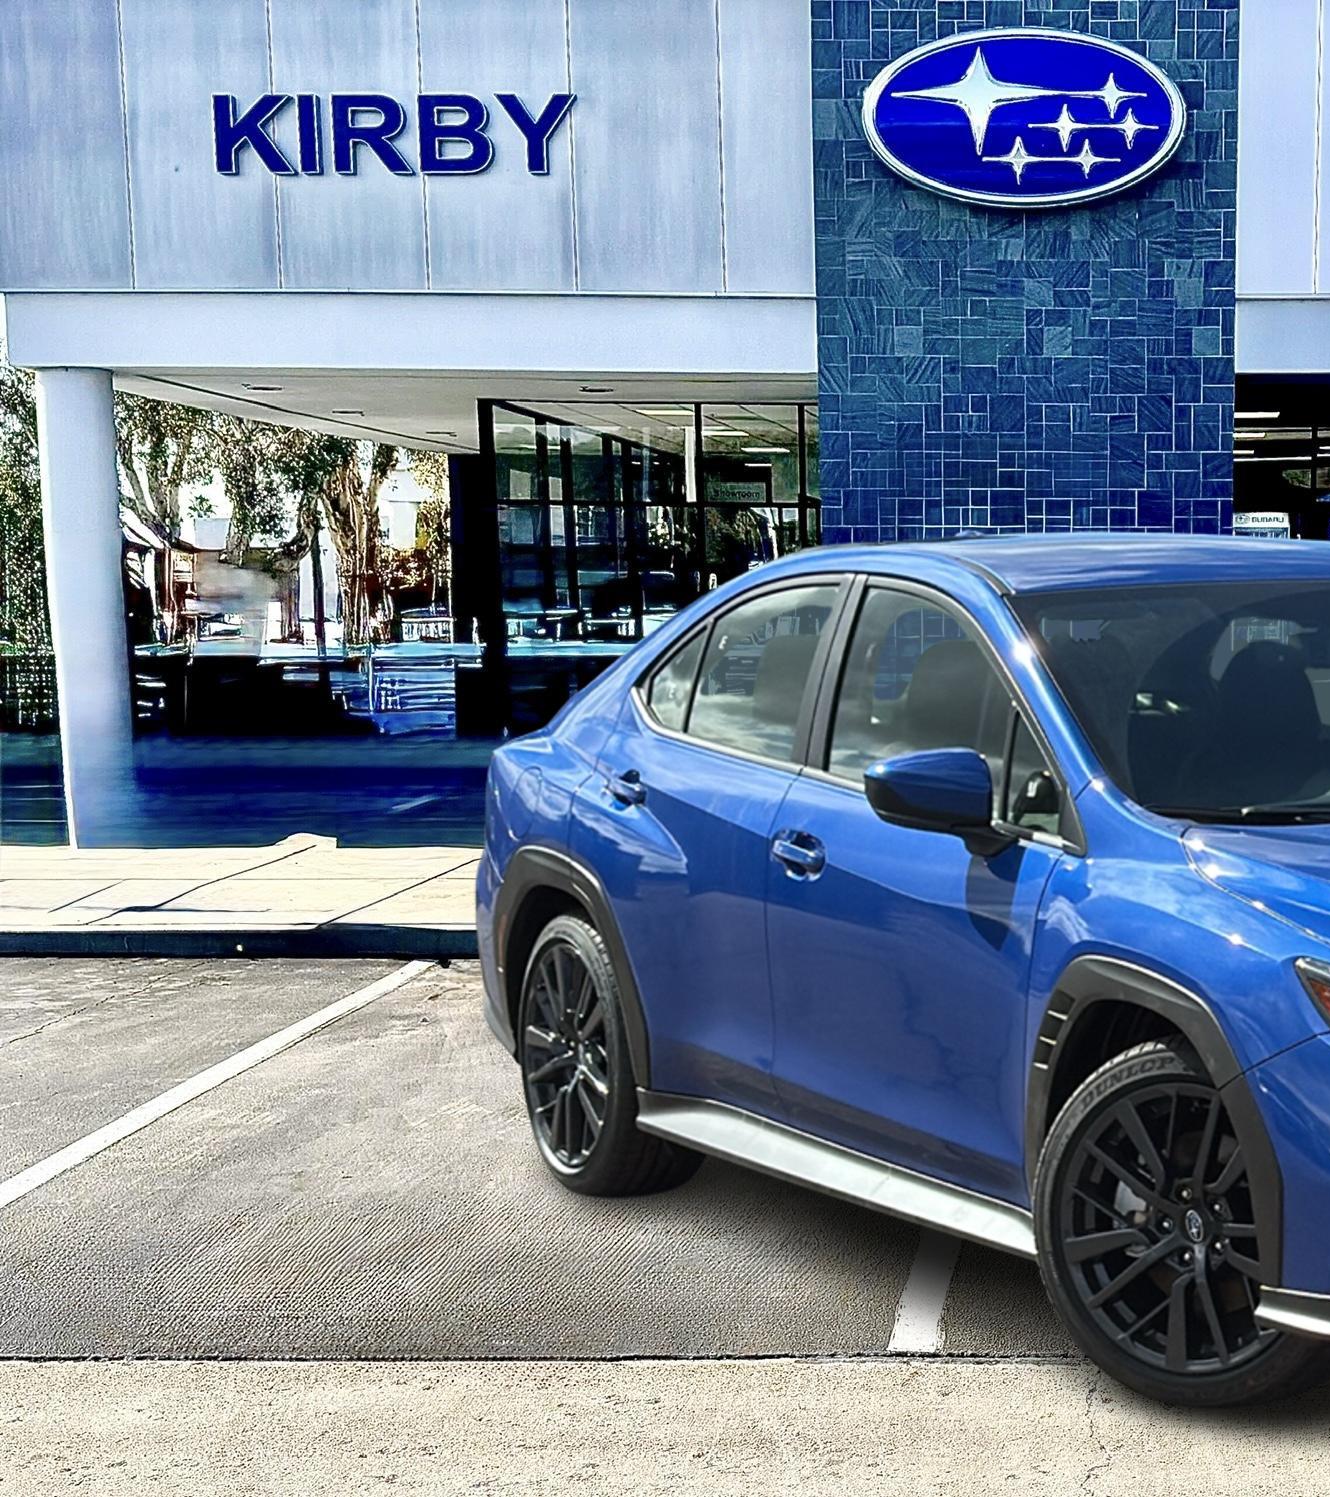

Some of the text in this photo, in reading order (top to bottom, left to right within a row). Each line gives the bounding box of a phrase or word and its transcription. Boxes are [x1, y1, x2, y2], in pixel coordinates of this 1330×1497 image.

[211, 93, 577, 175] KIRBY
[1251, 515, 1286, 523] SUBARU
[1081, 1056, 1175, 1112] DUNLOP
